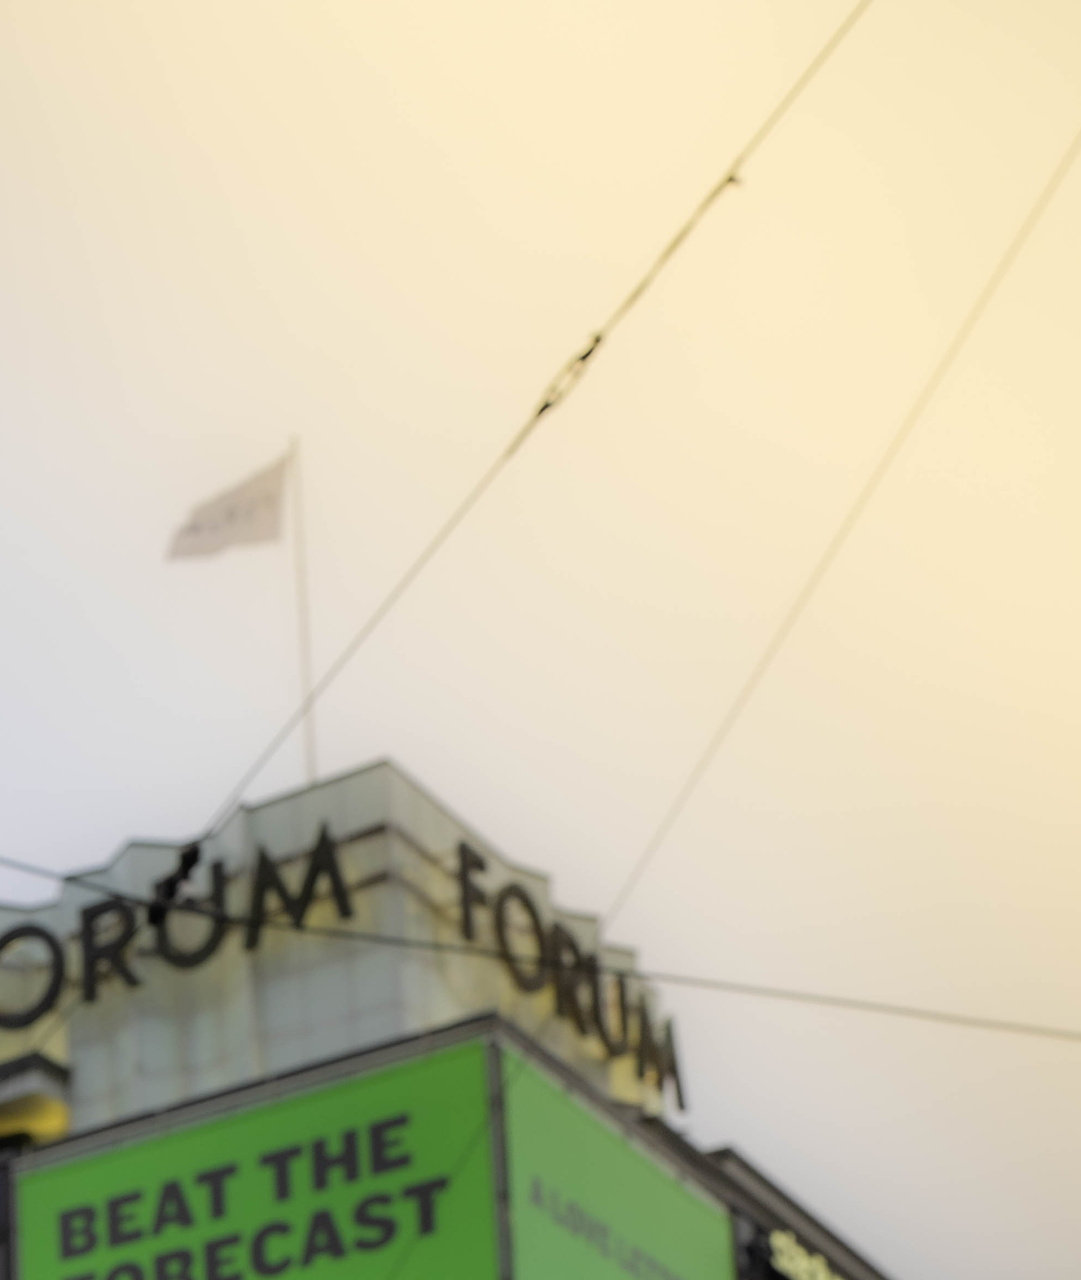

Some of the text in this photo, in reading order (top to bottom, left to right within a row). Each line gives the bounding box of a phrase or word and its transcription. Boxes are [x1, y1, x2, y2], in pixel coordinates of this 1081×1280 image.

[458, 841, 686, 1111] FORUM
[59, 1113, 412, 1261] BEAT THE
